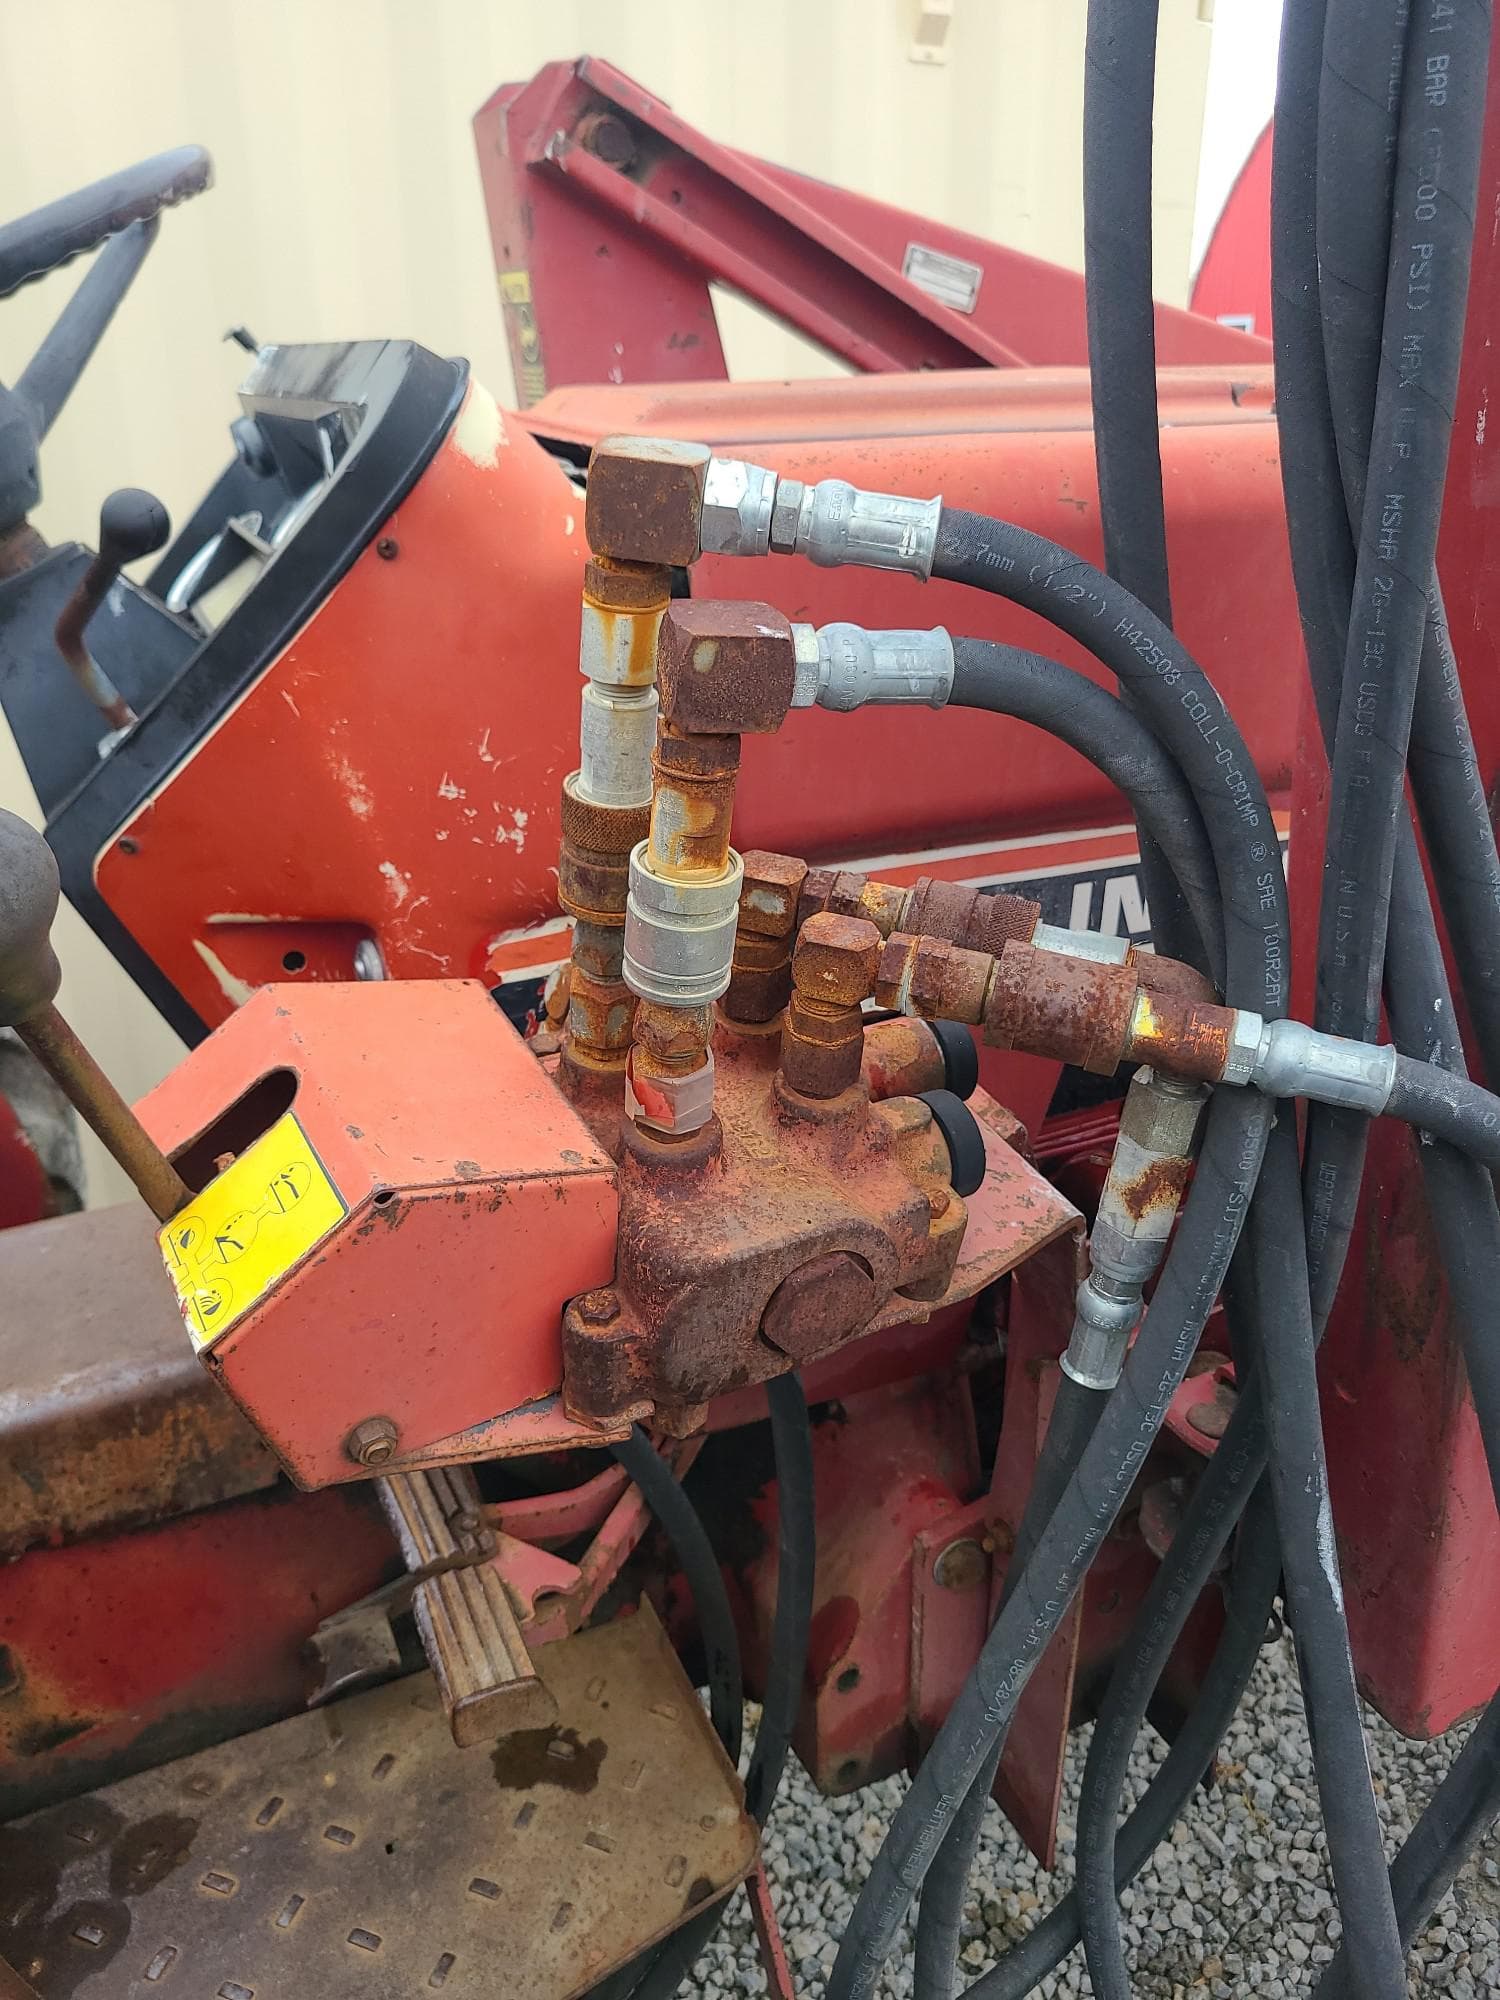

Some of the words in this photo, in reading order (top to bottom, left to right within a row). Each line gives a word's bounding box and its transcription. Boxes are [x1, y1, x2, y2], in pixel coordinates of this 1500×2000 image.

[1114, 617, 1181, 686] H42508
[1181, 690, 1259, 828] COLL-O-CRIMP
[1257, 872, 1277, 911] SAE
[1263, 921, 1282, 1008] 100R2AT
